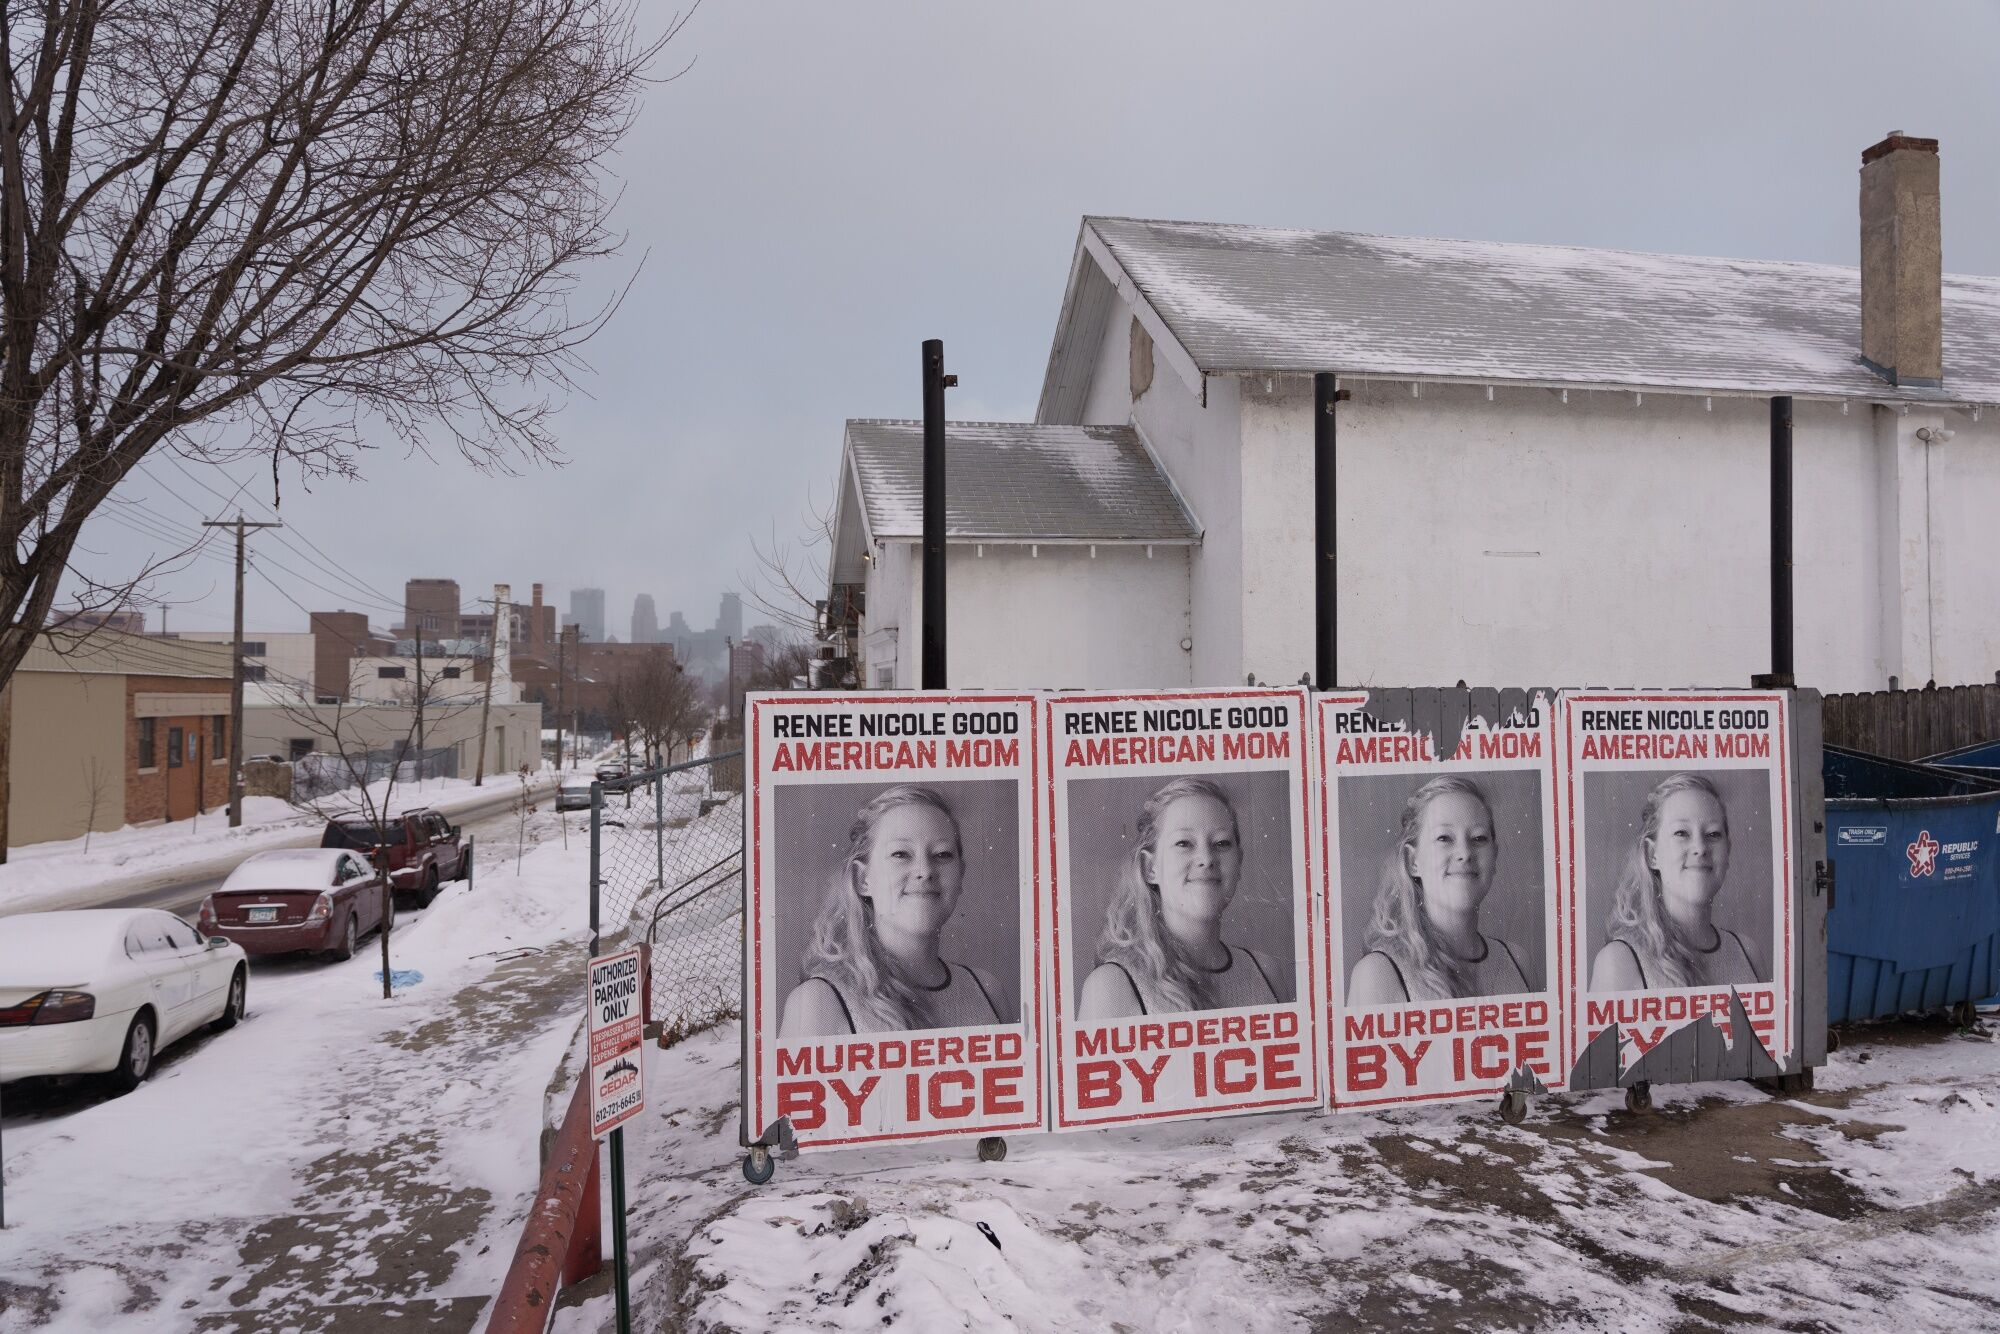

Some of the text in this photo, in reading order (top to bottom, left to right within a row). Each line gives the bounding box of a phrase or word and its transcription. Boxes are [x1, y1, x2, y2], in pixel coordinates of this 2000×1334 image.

[774, 712, 1018, 737] RENEE NICOLE GOOD
[1066, 706, 1288, 734] RENEE NICOLE GOOD
[1583, 710, 1769, 730] RENEE NICOLE GOOD
[773, 739, 1019, 772] AMERICAN MOM
[1065, 731, 1290, 767] AMERICAN MOM
[1336, 733, 1541, 765] AMERICN MOM
[1583, 733, 1770, 760] AMERICAN MOM
[1942, 841, 1978, 855] REPUBLIC
[1949, 852, 1971, 861] SERVICES
[592, 957, 637, 988] AUTHORIZED
[595, 977, 636, 1007] PARKING
[602, 998, 629, 1024] ONLY
[1345, 1000, 1548, 1042] MURDERED
[593, 1018, 640, 1044] TRESPASSERS TOWED
[593, 1044, 599, 1054] AT
[601, 1035, 620, 1050] VEHICLE
[1076, 1012, 1300, 1058] MURDERED
[593, 1046, 618, 1064] EXPENSE
[776, 1033, 1023, 1077] MURDERED
[1346, 1030, 1550, 1092] BY ICE
[600, 1071, 637, 1098] CEDAR
[1076, 1042, 1301, 1109] BY ICE
[595, 1092, 636, 1123] 612-721-6645
[777, 1065, 1024, 1130] BY ICE
